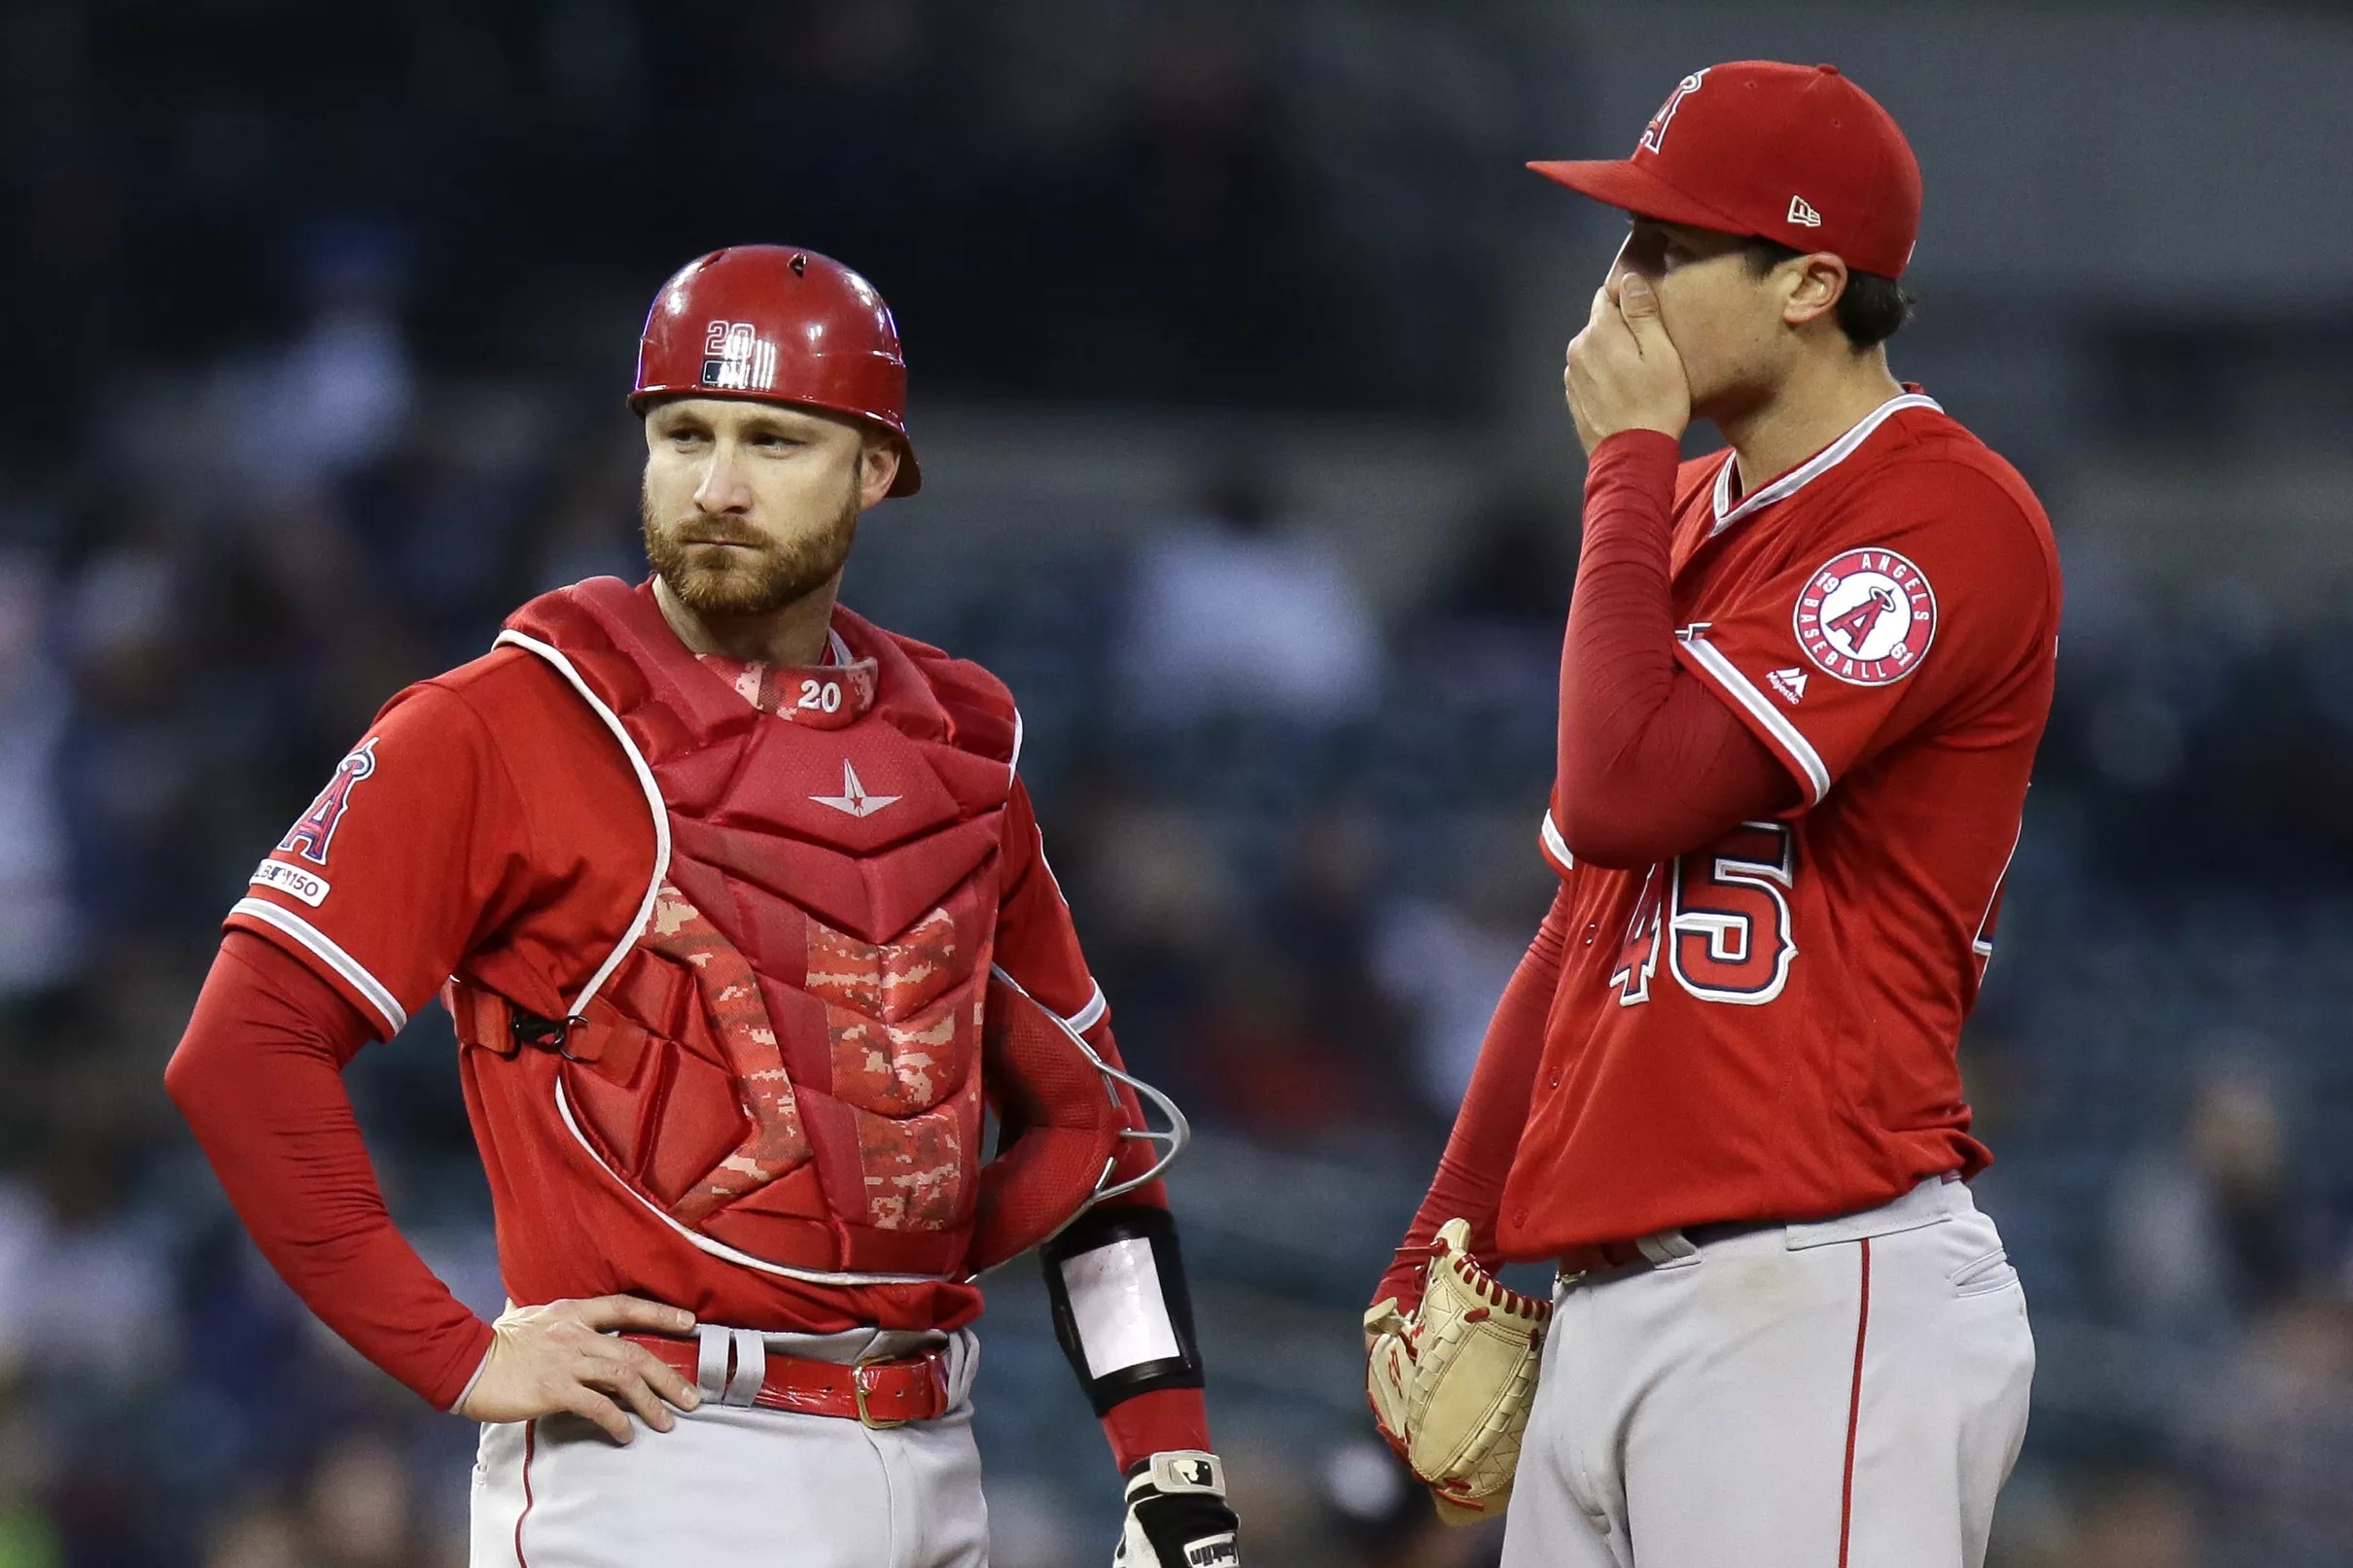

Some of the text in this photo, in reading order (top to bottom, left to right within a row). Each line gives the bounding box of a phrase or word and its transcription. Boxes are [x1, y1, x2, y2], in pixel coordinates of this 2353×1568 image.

[704, 320, 756, 360] 20
[1825, 585, 1896, 654] A
[1861, 553, 1930, 621] ANGELS
[1801, 597, 1886, 679] BASEBALL
[797, 679, 842, 713] 20
[1766, 671, 1800, 706] Majestic
[1609, 821, 1799, 1006] 45
